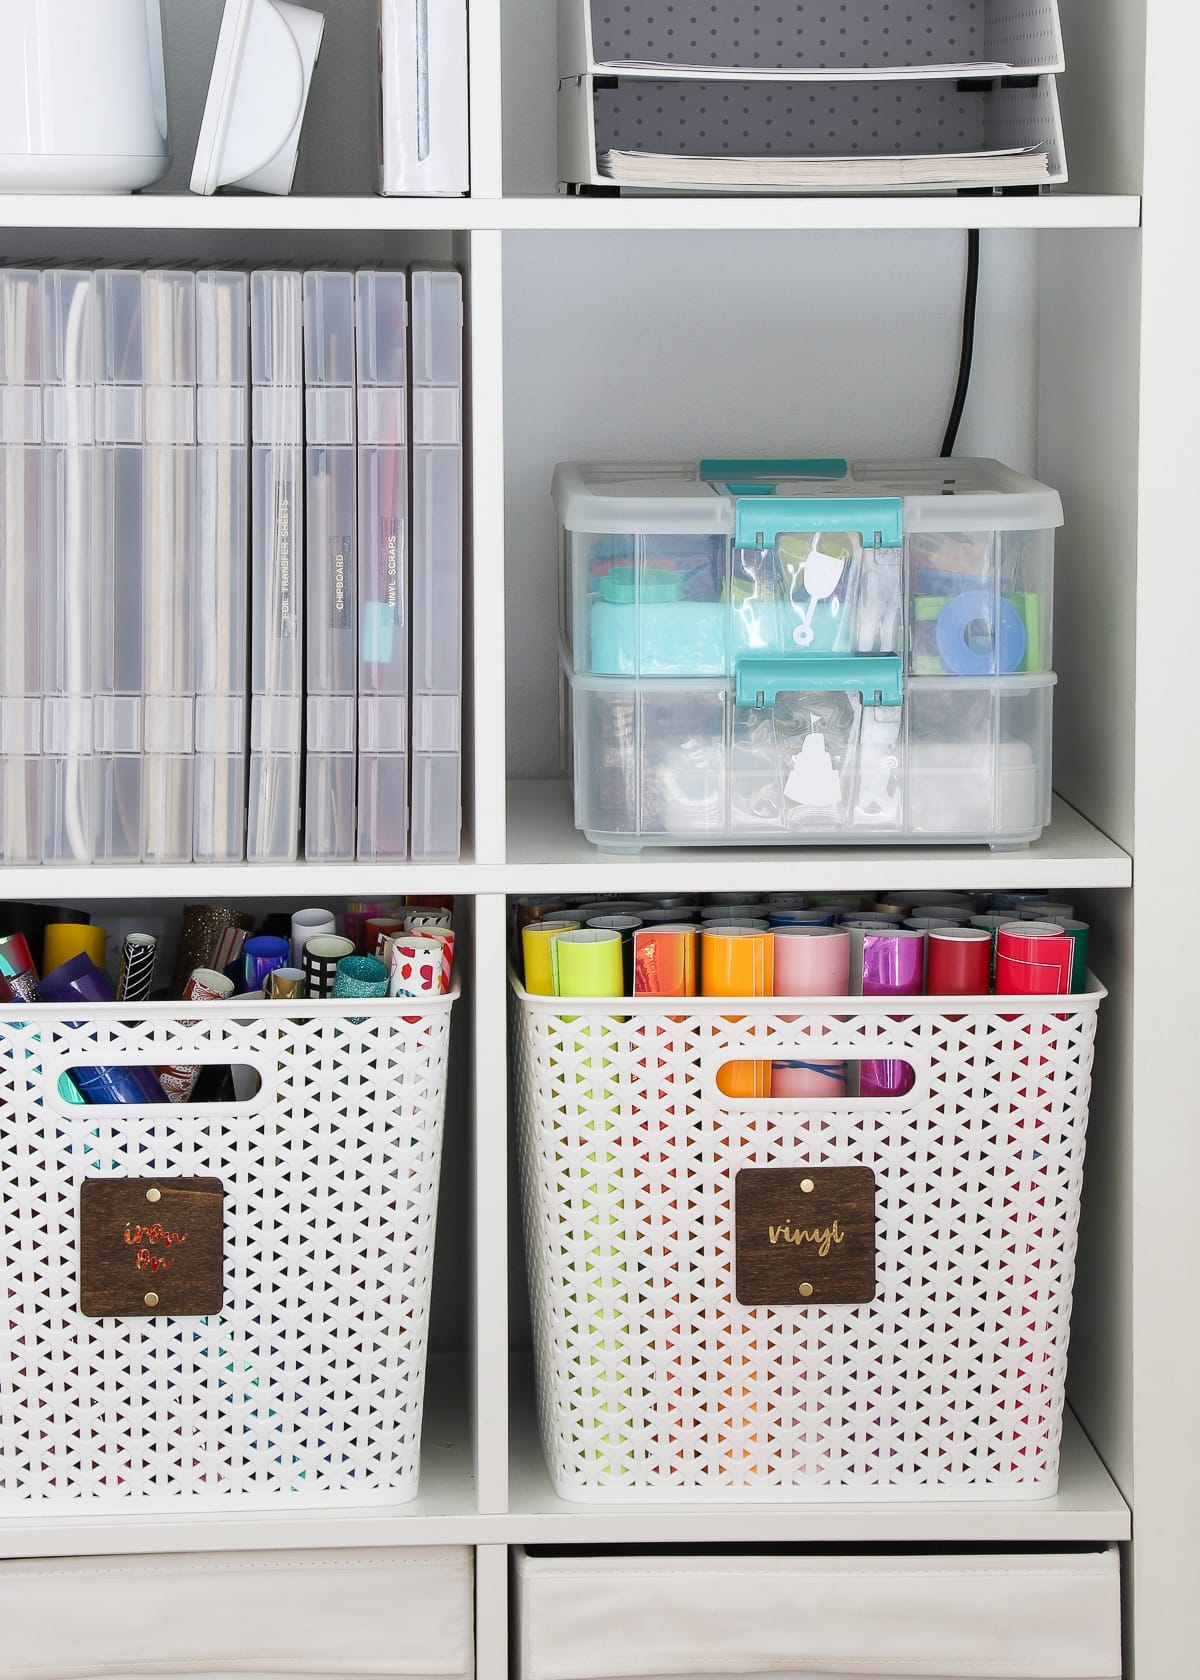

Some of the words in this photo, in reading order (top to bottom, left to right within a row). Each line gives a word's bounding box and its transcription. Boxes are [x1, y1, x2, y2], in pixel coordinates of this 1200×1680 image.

[279, 499, 289, 538] SHEETS
[280, 542, 290, 593] TRANSFER
[388, 535, 397, 576] SCRAPS
[335, 554, 344, 610] CHIPBOARD
[388, 579, 397, 608] VINYL
[281, 595, 290, 619] FOIL
[768, 1219, 845, 1256] vinyl
